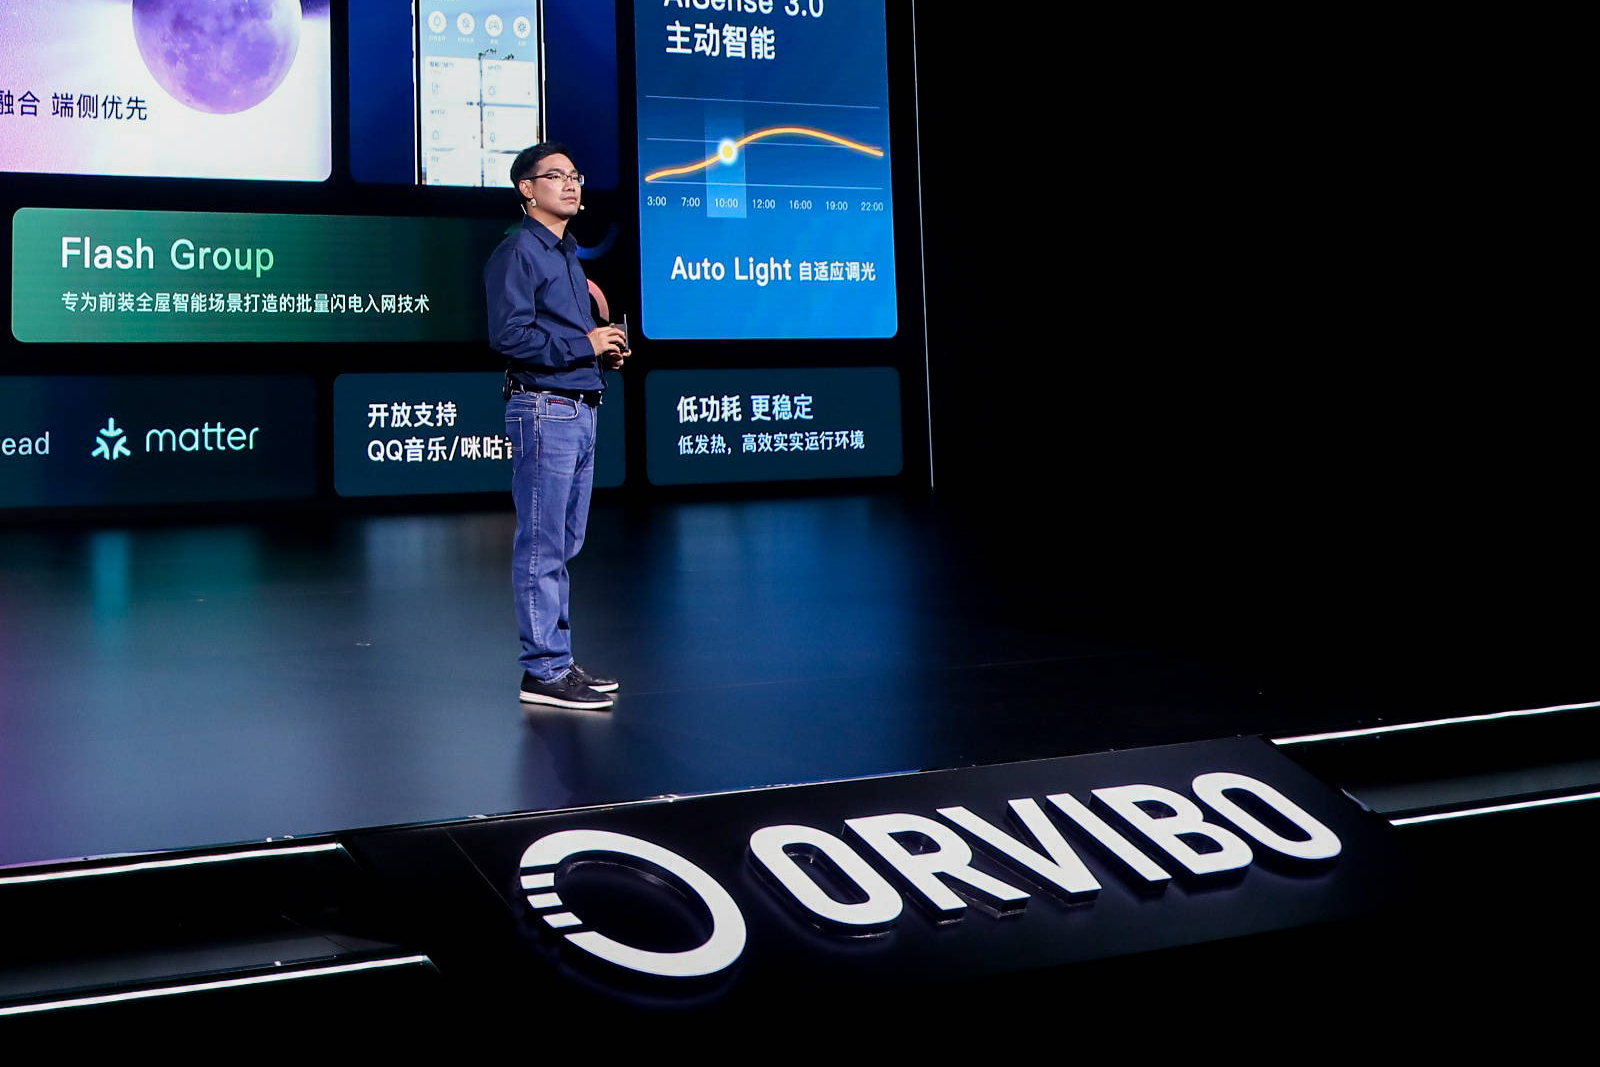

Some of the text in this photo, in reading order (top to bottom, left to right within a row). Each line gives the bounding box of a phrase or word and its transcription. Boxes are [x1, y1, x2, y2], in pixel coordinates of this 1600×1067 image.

[665, 20, 777, 61] 主动智能
[51, 92, 148, 121] 端侧优先
[647, 196, 884, 212] 3:00 7:00 10:00 12:00 16:00 19:00 22:00
[61, 236, 275, 278] Flash Group
[671, 256, 876, 286] Auto Light 自适应调光
[61, 291, 430, 314] 专为前装全屋智能场景打造的批量闪电入网技术
[367, 401, 458, 428] 开放支持
[677, 393, 814, 423] 低功耗 更稳定
[146, 420, 259, 454] matter
[748, 772, 1342, 926] ORVIBO
